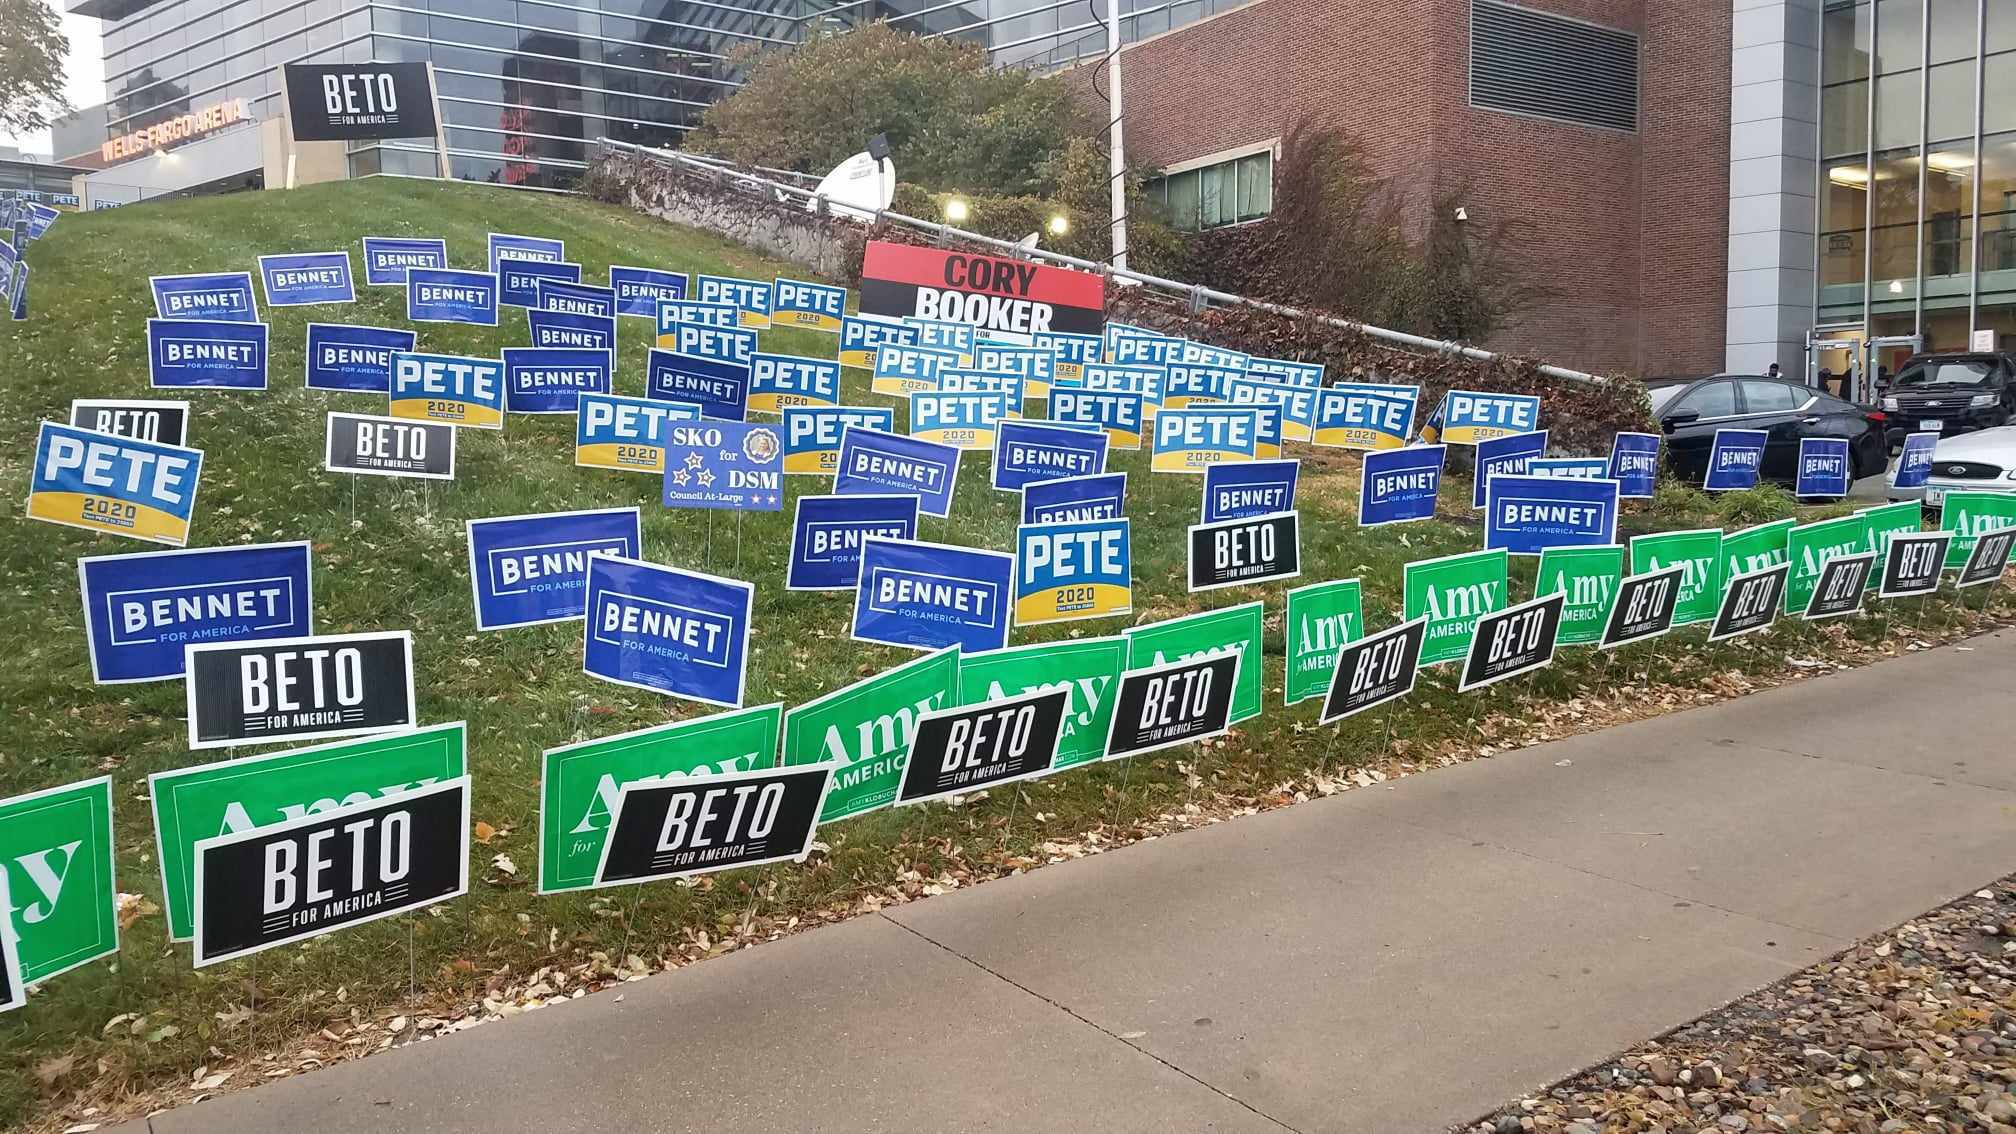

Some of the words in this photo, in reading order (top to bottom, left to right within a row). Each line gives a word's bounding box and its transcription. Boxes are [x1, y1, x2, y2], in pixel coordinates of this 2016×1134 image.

[323, 73, 397, 114] BETO
[102, 130, 144, 161] WELLS
[147, 115, 193, 147] FARGO
[193, 98, 241, 133] ARENA
[342, 116, 354, 124] FOR
[357, 115, 386, 124] AMERICA
[53, 196, 78, 205] PETE
[378, 254, 434, 267] BENNET
[275, 270, 339, 286] BENNET
[511, 277, 538, 289] BEN
[944, 255, 1038, 296] CORY
[170, 293, 240, 311] BENNET
[421, 288, 485, 304] BENNET
[622, 285, 676, 299] BENNET
[702, 281, 768, 310] PETE
[779, 284, 841, 314] PETE
[549, 299, 604, 316] BENNET
[796, 312, 820, 322] 2020
[915, 287, 1053, 333] BOOKER
[542, 330, 602, 348] BENNET
[681, 326, 751, 361] PETE
[846, 322, 915, 346] PETE
[168, 343, 252, 363] BENNET
[324, 348, 389, 366] BENNE
[1119, 338, 1182, 367] PETE
[1183, 345, 1244, 368] PETE
[982, 352, 1050, 378] PETE
[397, 360, 497, 400] PETE
[520, 371, 597, 388] BENNET
[662, 373, 734, 398] BENNET
[752, 359, 835, 396] PETE
[901, 380, 928, 390] 2020
[1087, 369, 1160, 398] PETE
[777, 395, 808, 406] 2020
[943, 375, 1018, 405] PETE
[427, 401, 465, 414] 2020
[916, 396, 1001, 426] PETE
[1055, 394, 1136, 425] PETE
[1234, 385, 1311, 419] PETE
[1322, 396, 1407, 431] PETE
[1451, 397, 1532, 427] PETE
[97, 410, 159, 443] BETO
[673, 427, 721, 447] SKO
[943, 431, 975, 440] 2020
[1160, 416, 1250, 447] PETE
[1346, 430, 1377, 440] 2020
[1473, 428, 1504, 437] 2020
[356, 422, 426, 460] BETO
[617, 446, 657, 459] 2020
[370, 458, 381, 466] FOR
[384, 460, 412, 468] AMERICA
[720, 450, 738, 461] for
[820, 453, 836, 462] 20
[1013, 449, 1090, 472] BENNET
[1187, 452, 1220, 461] 2020
[1620, 456, 1655, 473] BENNET
[1721, 452, 1756, 466] BENNET
[44, 434, 190, 505] PETE
[728, 470, 779, 489] DSM
[855, 454, 939, 486] BENNET
[871, 477, 885, 485] FOR
[887, 479, 918, 491] AMERICA
[1377, 472, 1435, 497] BENNET
[83, 497, 137, 519] 2020
[670, 491, 702, 500] Council
[704, 491, 743, 502] At-Large
[1220, 489, 1283, 511] BENNET
[1504, 505, 1596, 527] BENNET
[1540, 527, 1574, 535] AMERICA
[1025, 529, 1122, 584] PETE
[1215, 524, 1275, 569] BETO
[1974, 536, 2010, 570] BETO
[832, 555, 847, 564] FOR
[1899, 543, 1937, 578] BETO
[530, 583, 552, 593] FOR
[555, 578, 586, 591] AMERI
[1551, 570, 1614, 612] Amy
[1824, 563, 1863, 601] BETO
[879, 577, 989, 617] BENNET
[1057, 587, 1094, 603] 2020
[1424, 581, 1499, 622] Amy
[1624, 577, 1670, 626] BETO
[1732, 575, 1776, 619] BETO
[123, 588, 281, 634] BENNET
[899, 609, 917, 619] FOR
[920, 612, 962, 625] AMERICA
[160, 631, 187, 643] FOR
[191, 625, 250, 640] AMERICA
[604, 602, 721, 653] BENNET
[1430, 619, 1476, 639] AMERIC
[1488, 607, 1546, 664] BETO
[623, 640, 645, 652] FOR
[647, 645, 690, 663] AMERICA
[1349, 633, 1407, 695] BETO
[1495, 662, 1504, 672] FOR
[1505, 655, 1526, 669] AMERICA
[241, 648, 363, 714] BETO
[1139, 667, 1213, 730] BETO
[267, 716, 288, 729] FOR
[293, 711, 341, 727] AMERICA
[1150, 728, 1163, 740] FOR
[1164, 722, 1191, 738] AMERICA
[941, 705, 1036, 773] BETO
[830, 755, 905, 794] AMERIC
[953, 770, 970, 784] FOR
[972, 762, 1008, 782] AMERICA
[656, 782, 786, 853] BETO
[569, 839, 596, 857] for
[674, 853, 697, 866] FOR
[699, 845, 745, 862] AMERICA
[263, 810, 411, 915] BETO
[292, 909, 317, 927] FOR
[323, 891, 382, 919] AMERICA
